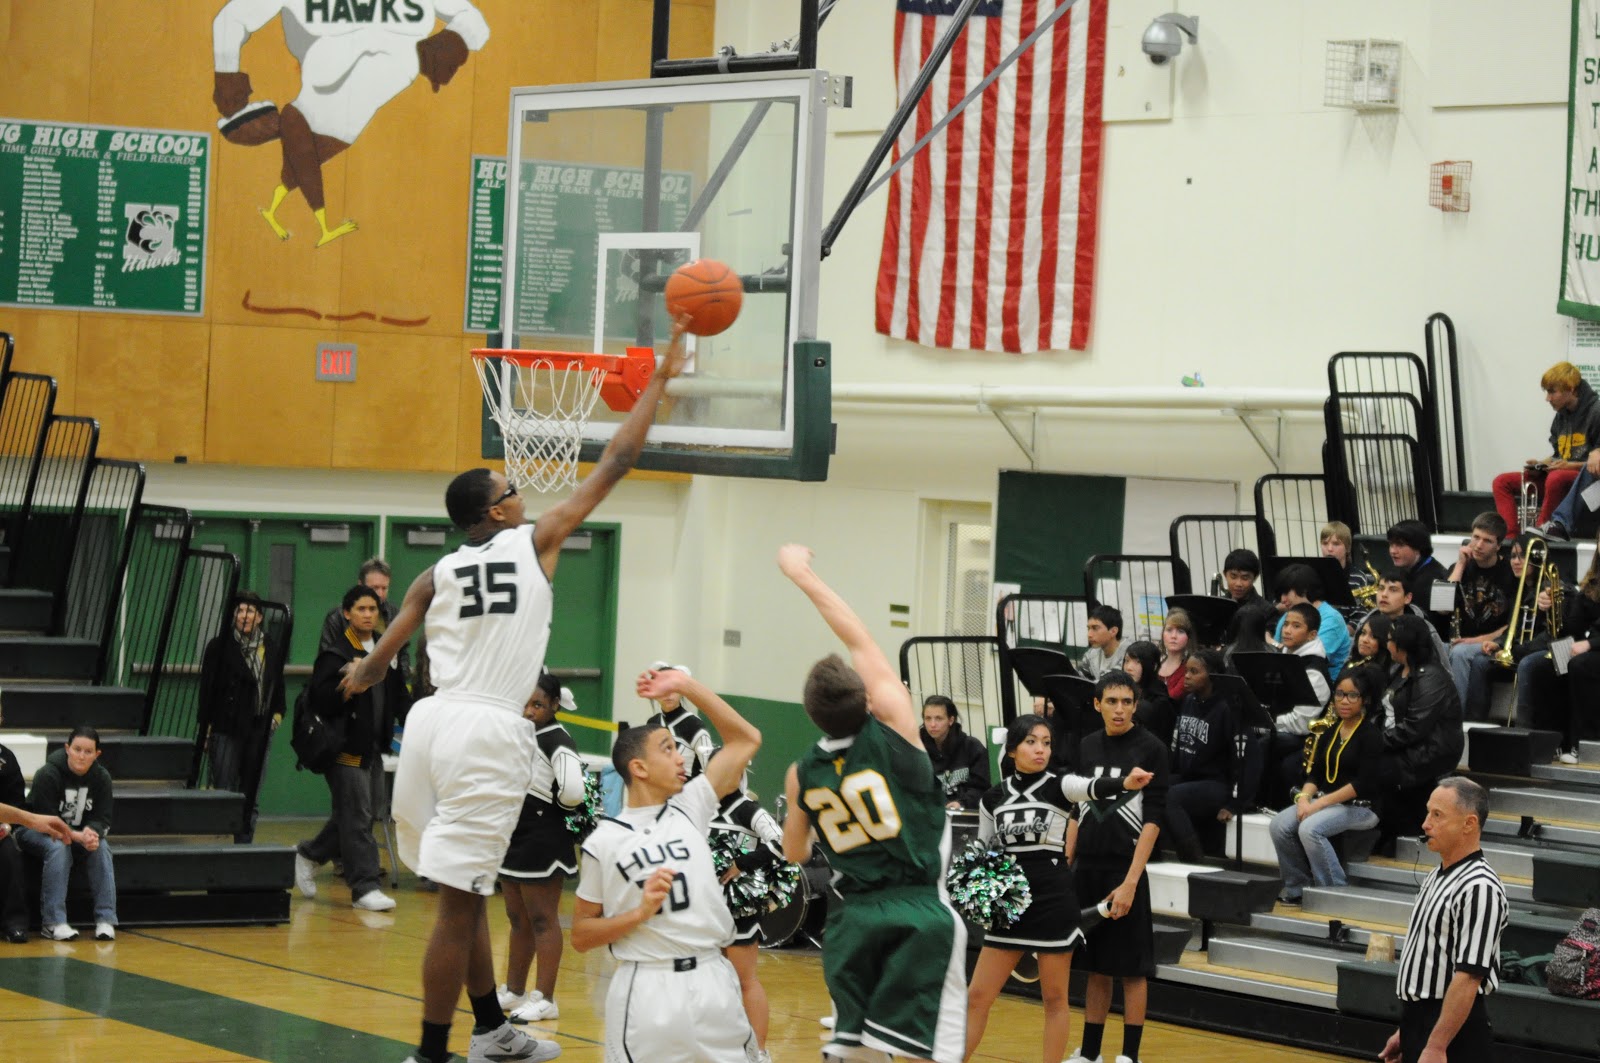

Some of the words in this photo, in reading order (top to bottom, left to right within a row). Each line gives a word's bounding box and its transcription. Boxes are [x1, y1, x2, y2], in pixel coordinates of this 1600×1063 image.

[305, 0, 424, 23] HAWKS
[30, 146, 61, 157] GIRLS
[65, 148, 99, 159] TRACK
[117, 152, 147, 162] FIELD
[150, 154, 196, 166] RECORDS
[32, 126, 99, 149] HIGH
[109, 132, 204, 157] SCHOOL
[534, 165, 594, 187] HIGH
[604, 171, 688, 194] SCHOL
[559, 184, 590, 195] TRACK
[607, 189, 634, 198] FIELD
[321, 349, 352, 375] EXIT
[454, 562, 517, 618] 35
[804, 768, 902, 854] 20
[616, 839, 690, 882] HUG
